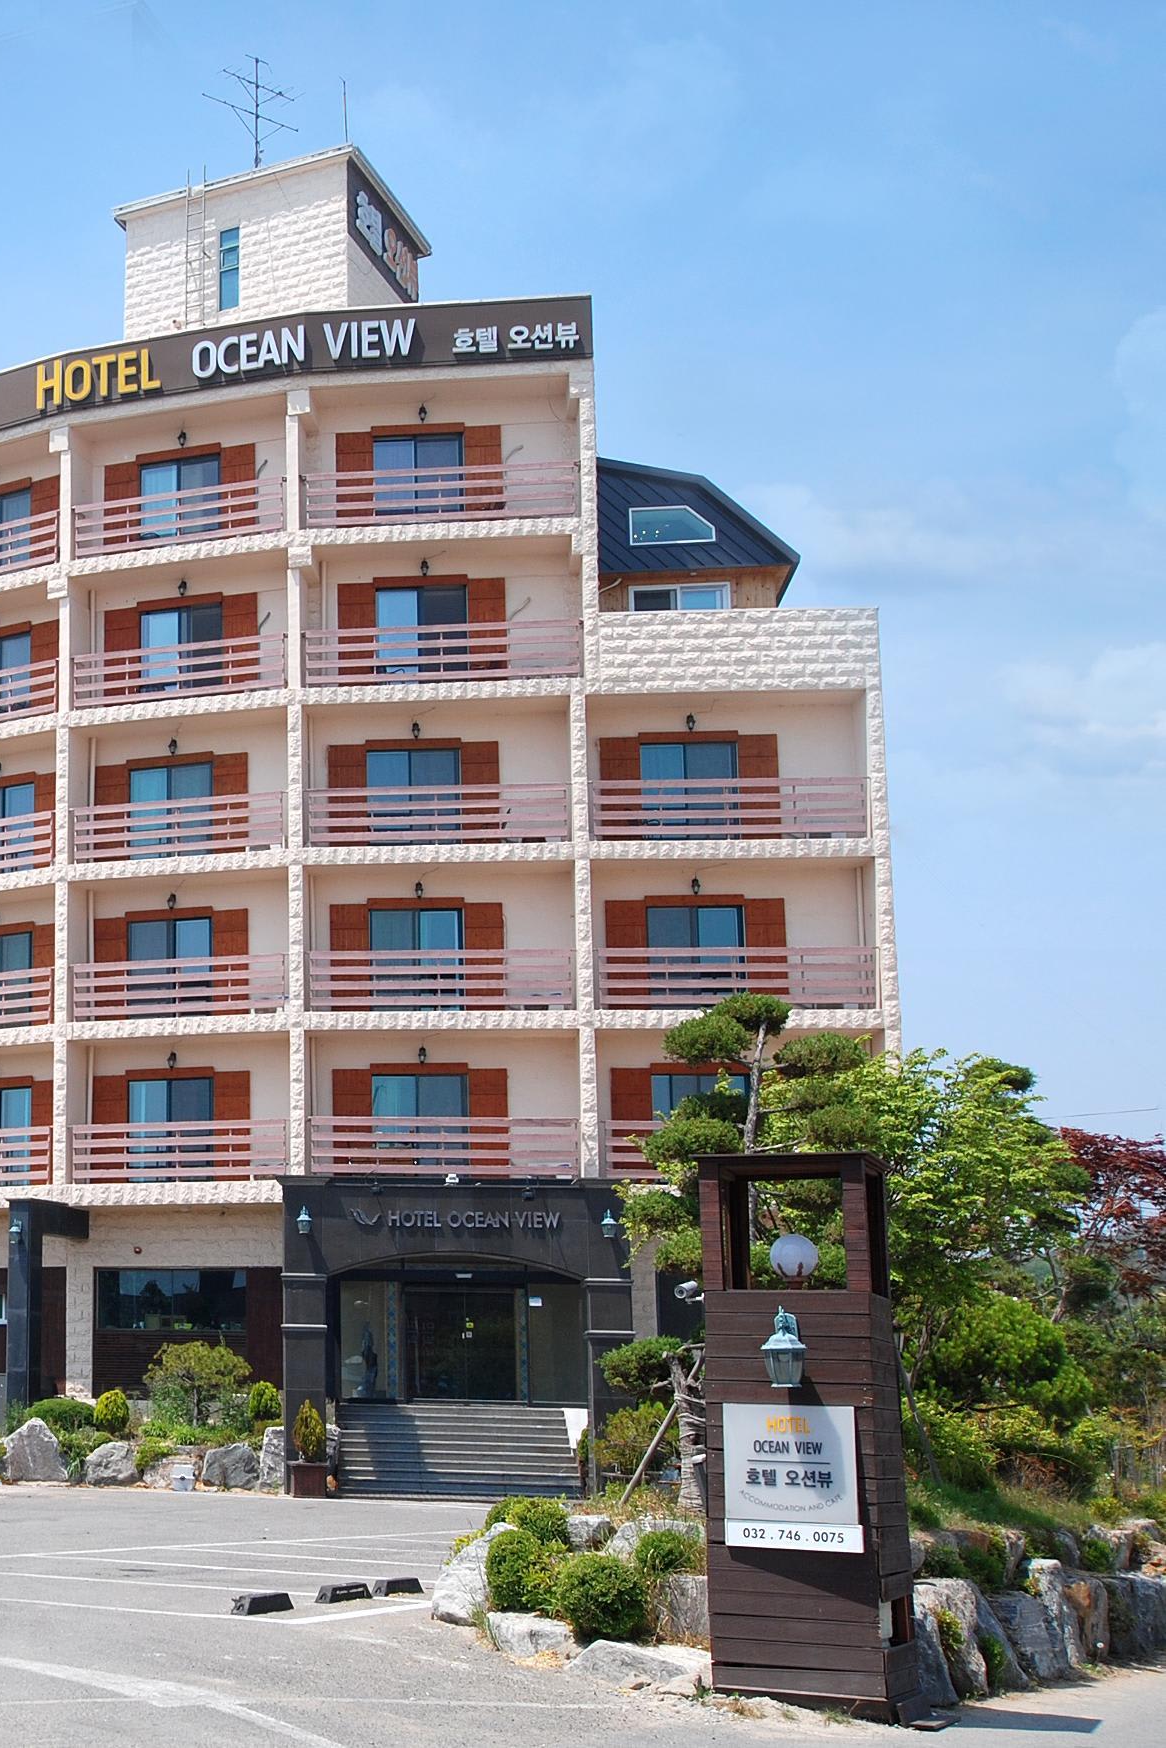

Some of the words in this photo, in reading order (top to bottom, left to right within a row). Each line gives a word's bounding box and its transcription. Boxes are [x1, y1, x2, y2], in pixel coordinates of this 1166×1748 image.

[451, 325, 499, 354] 호텔
[507, 320, 580, 350] 오션뷰
[36, 348, 161, 411] HOTEL
[191, 324, 306, 379] OCEAN
[322, 317, 416, 360] VIEW
[387, 1210, 442, 1229] HOTEL
[446, 1210, 510, 1230] OCEAN
[515, 1210, 562, 1230] VIEW
[766, 1415, 811, 1435] HOTEL
[753, 1439, 790, 1455] OCEAN
[794, 1441, 823, 1456] VIEW
[745, 1467, 778, 1487] 호텔
[784, 1469, 834, 1489] 오션뷰
[739, 1489, 806, 1512] ACCOMMODATION
[808, 1503, 824, 1512] AND
[742, 1527, 766, 1539] 032
[778, 1529, 801, 1542] 746
[813, 1531, 844, 1544] 0075
